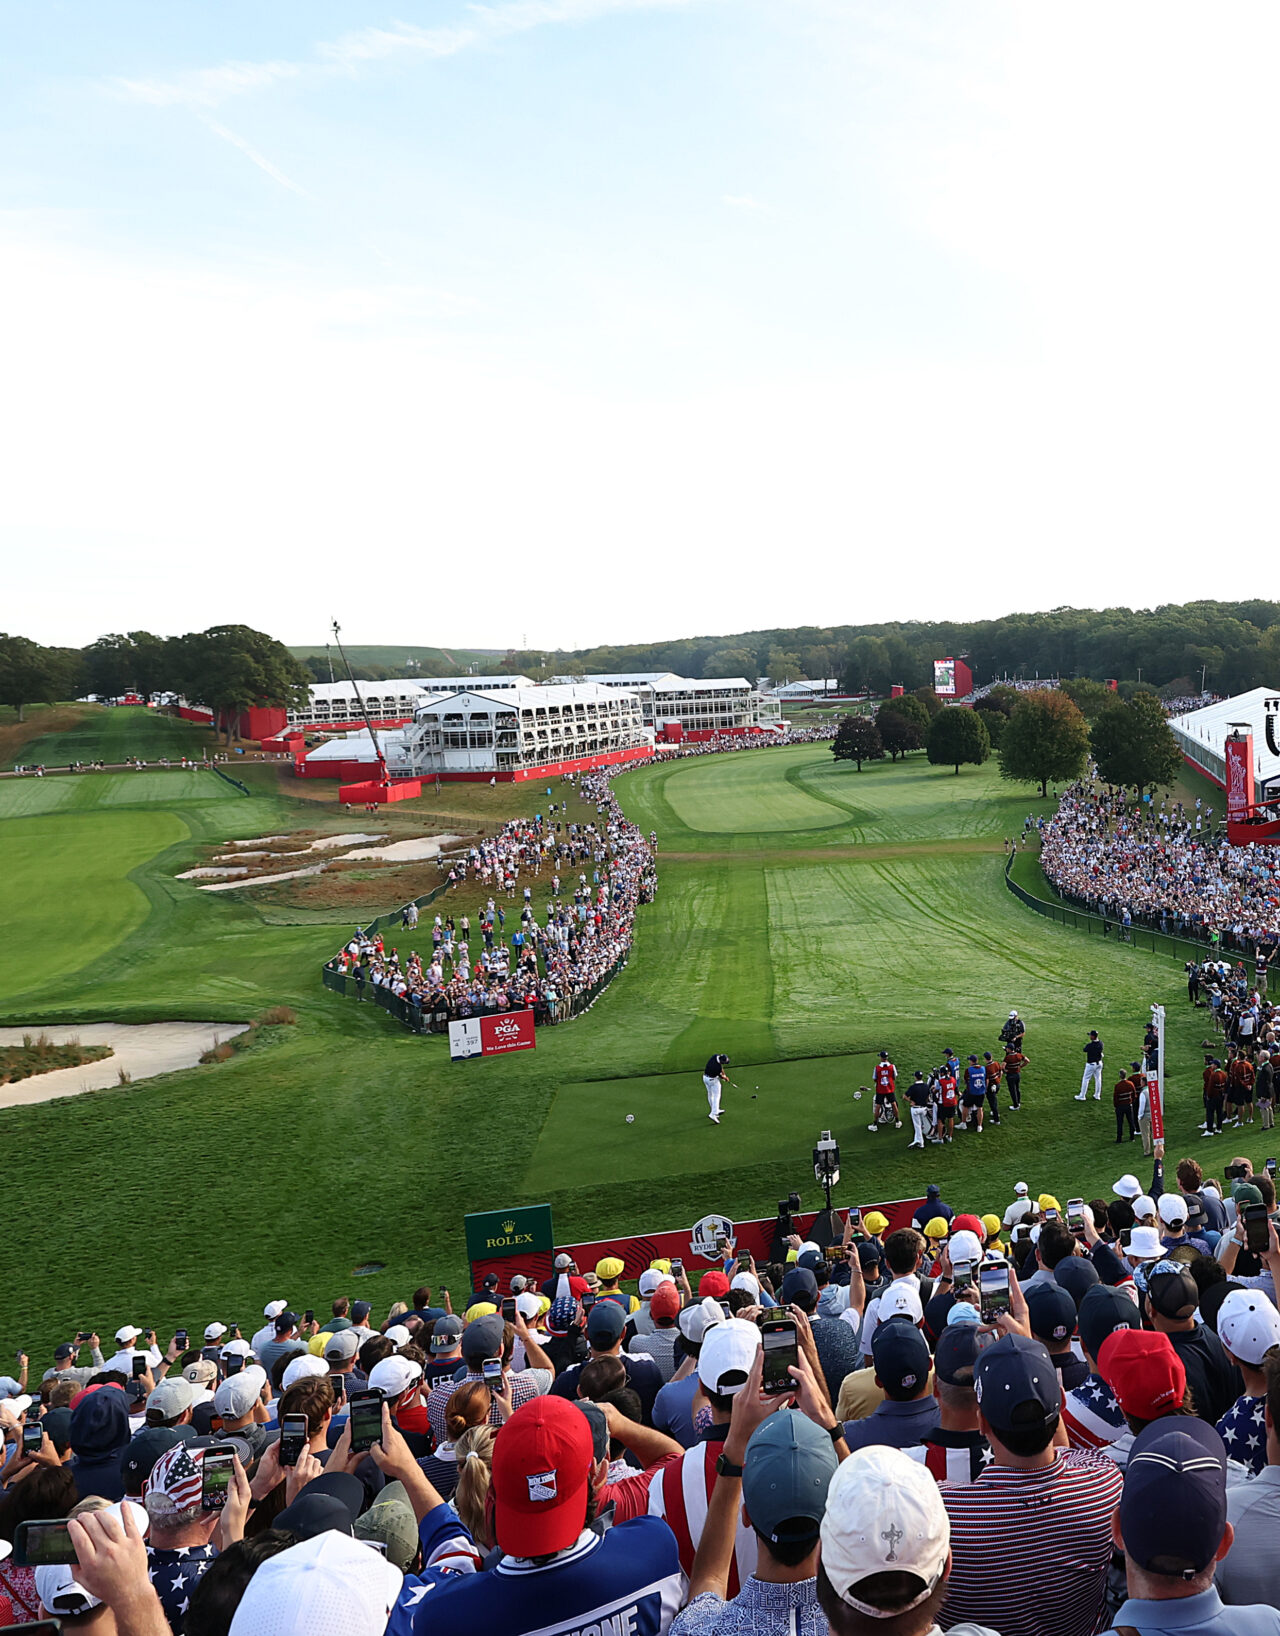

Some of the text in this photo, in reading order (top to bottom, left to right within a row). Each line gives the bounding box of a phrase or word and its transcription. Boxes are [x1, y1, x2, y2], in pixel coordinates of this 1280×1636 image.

[461, 1023, 467, 1035] 1
[494, 1023, 520, 1035] PGA
[486, 1233, 534, 1248] ROLEX
